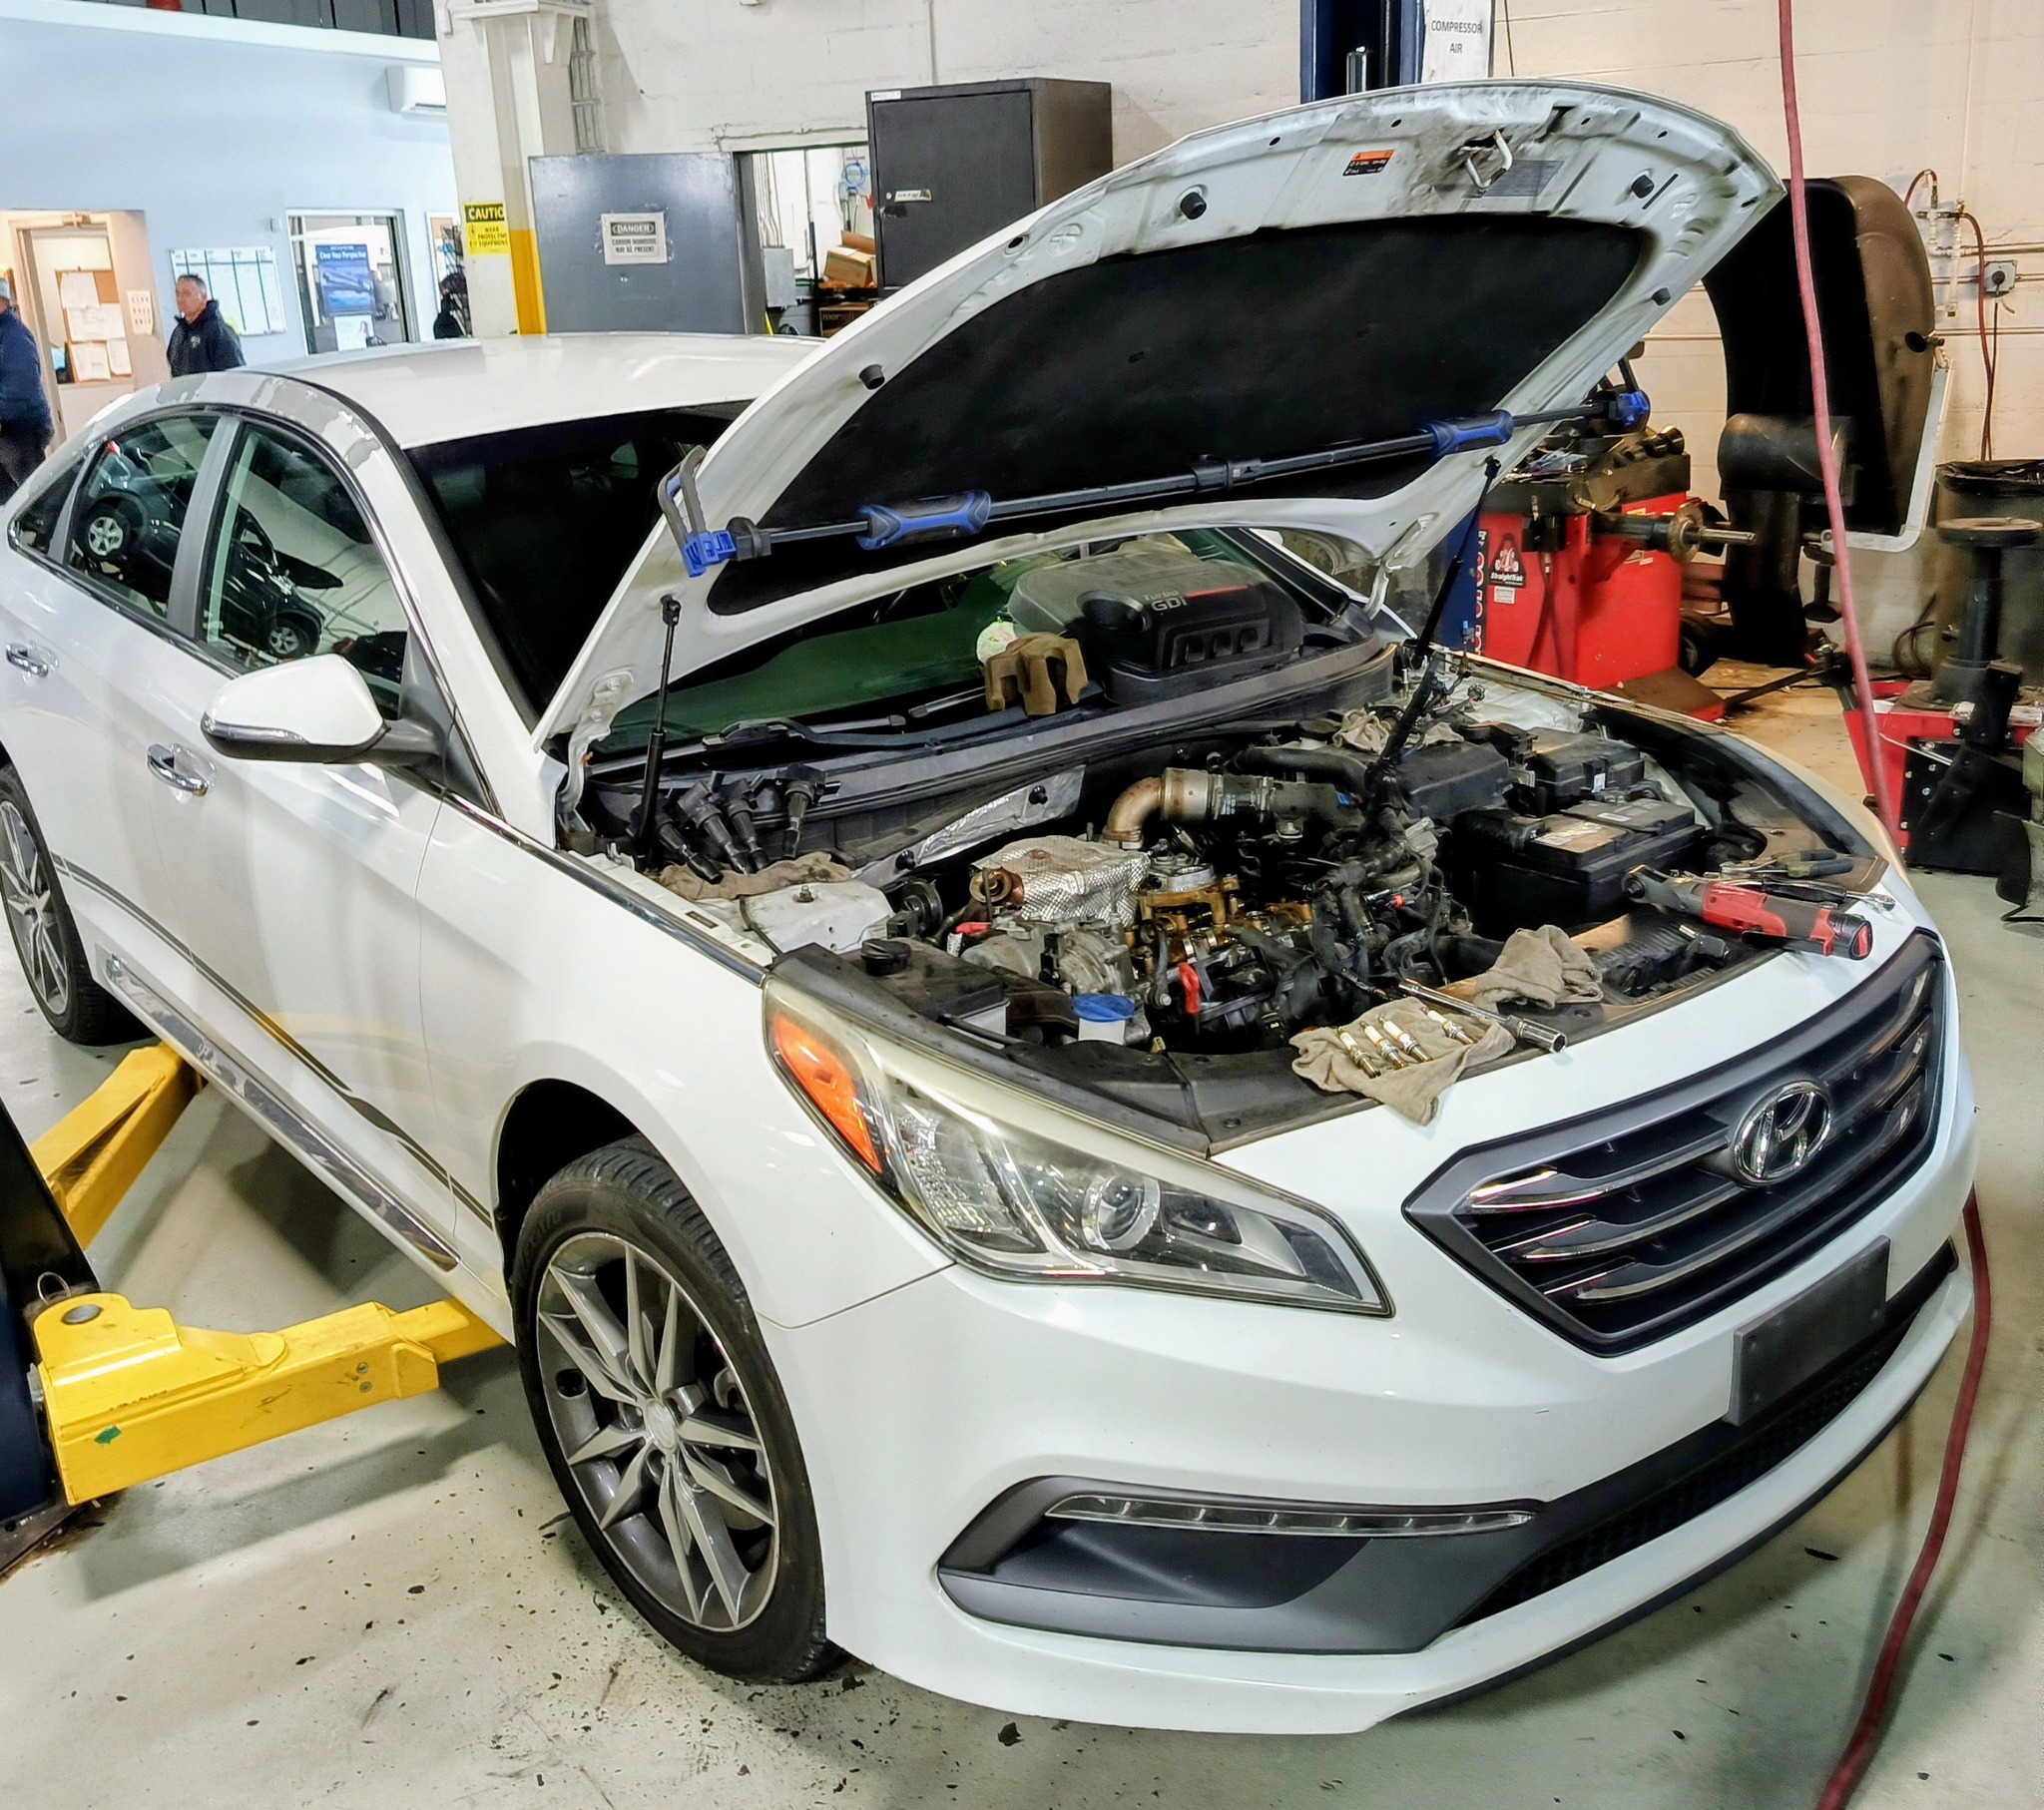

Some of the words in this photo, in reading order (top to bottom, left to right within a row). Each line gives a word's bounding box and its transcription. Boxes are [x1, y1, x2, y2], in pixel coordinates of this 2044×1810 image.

[1431, 20, 1483, 34] COMPRESSOR
[1449, 43, 1463, 54] AIR
[617, 224, 651, 233] DANGER
[1143, 590, 1179, 601] Turbo
